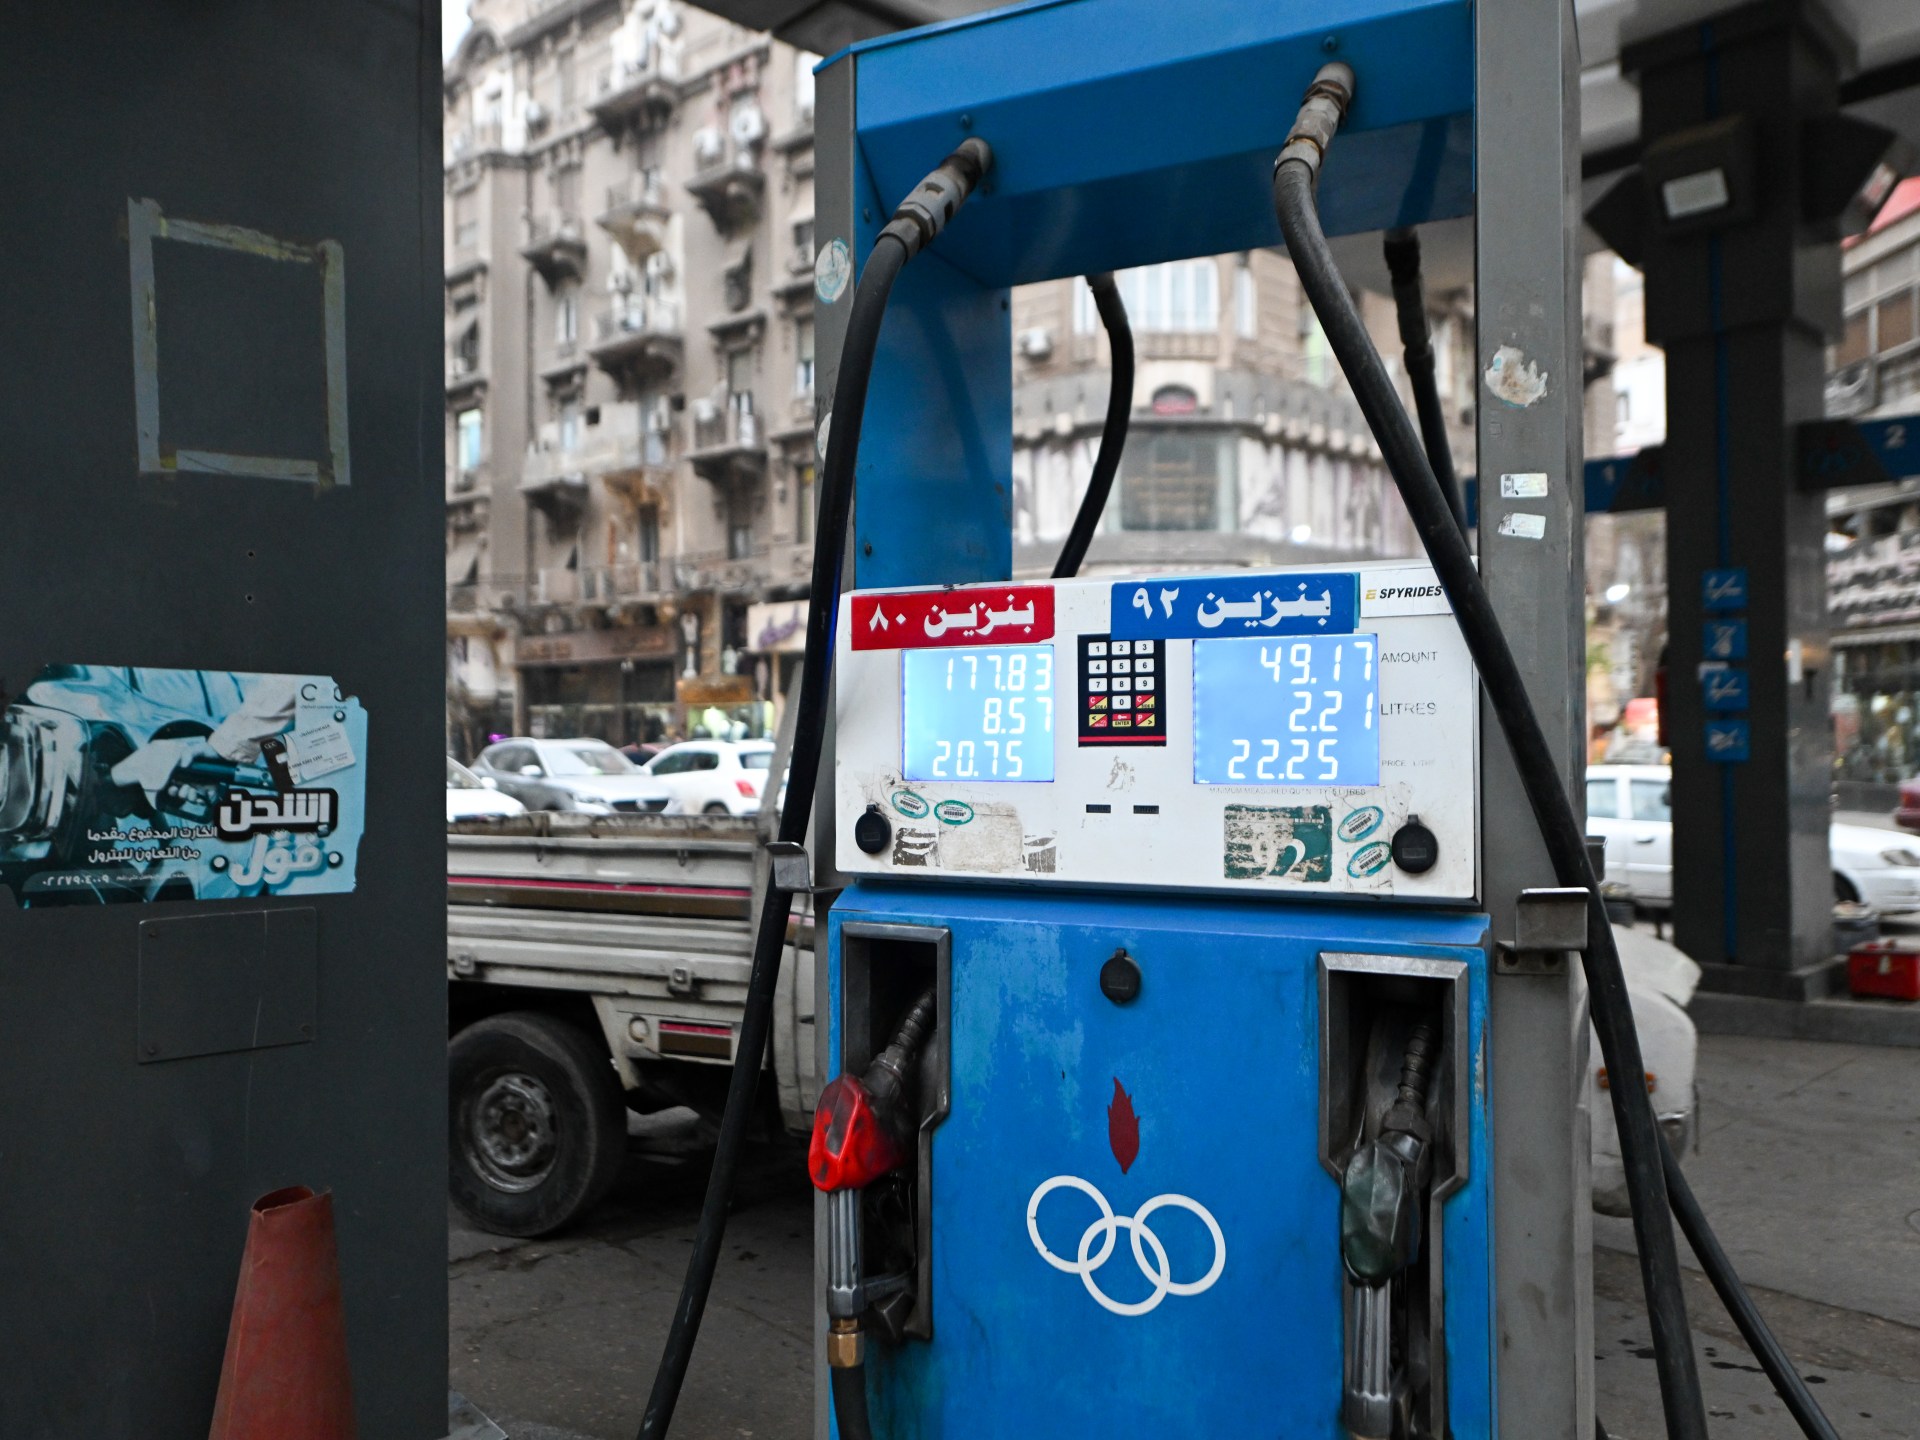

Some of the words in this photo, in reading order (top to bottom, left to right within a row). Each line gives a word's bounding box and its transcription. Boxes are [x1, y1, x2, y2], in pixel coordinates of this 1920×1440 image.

[1132, 587, 1180, 620] ٩٢
[1197, 582, 1331, 628] بنزين
[1379, 585, 1443, 599] SPYRIDES
[869, 603, 907, 632] ٨٠
[924, 593, 1035, 638] بنزين
[946, 653, 1052, 691] 177.83
[1260, 641, 1373, 685] 49.17
[1381, 651, 1438, 664] AMOUNT
[983, 697, 1053, 734] 8.57
[1289, 690, 1374, 732] 2.21
[1381, 702, 1437, 716] LITRES
[932, 740, 1023, 777] 20.75
[1228, 739, 1338, 780] 22.25
[87, 827, 126, 841] مقدما
[128, 827, 177, 841] المدفوع
[179, 826, 218, 840] الكارت
[88, 848, 133, 863] للبترول
[135, 846, 179, 861] التعاون
[181, 847, 200, 860] من
